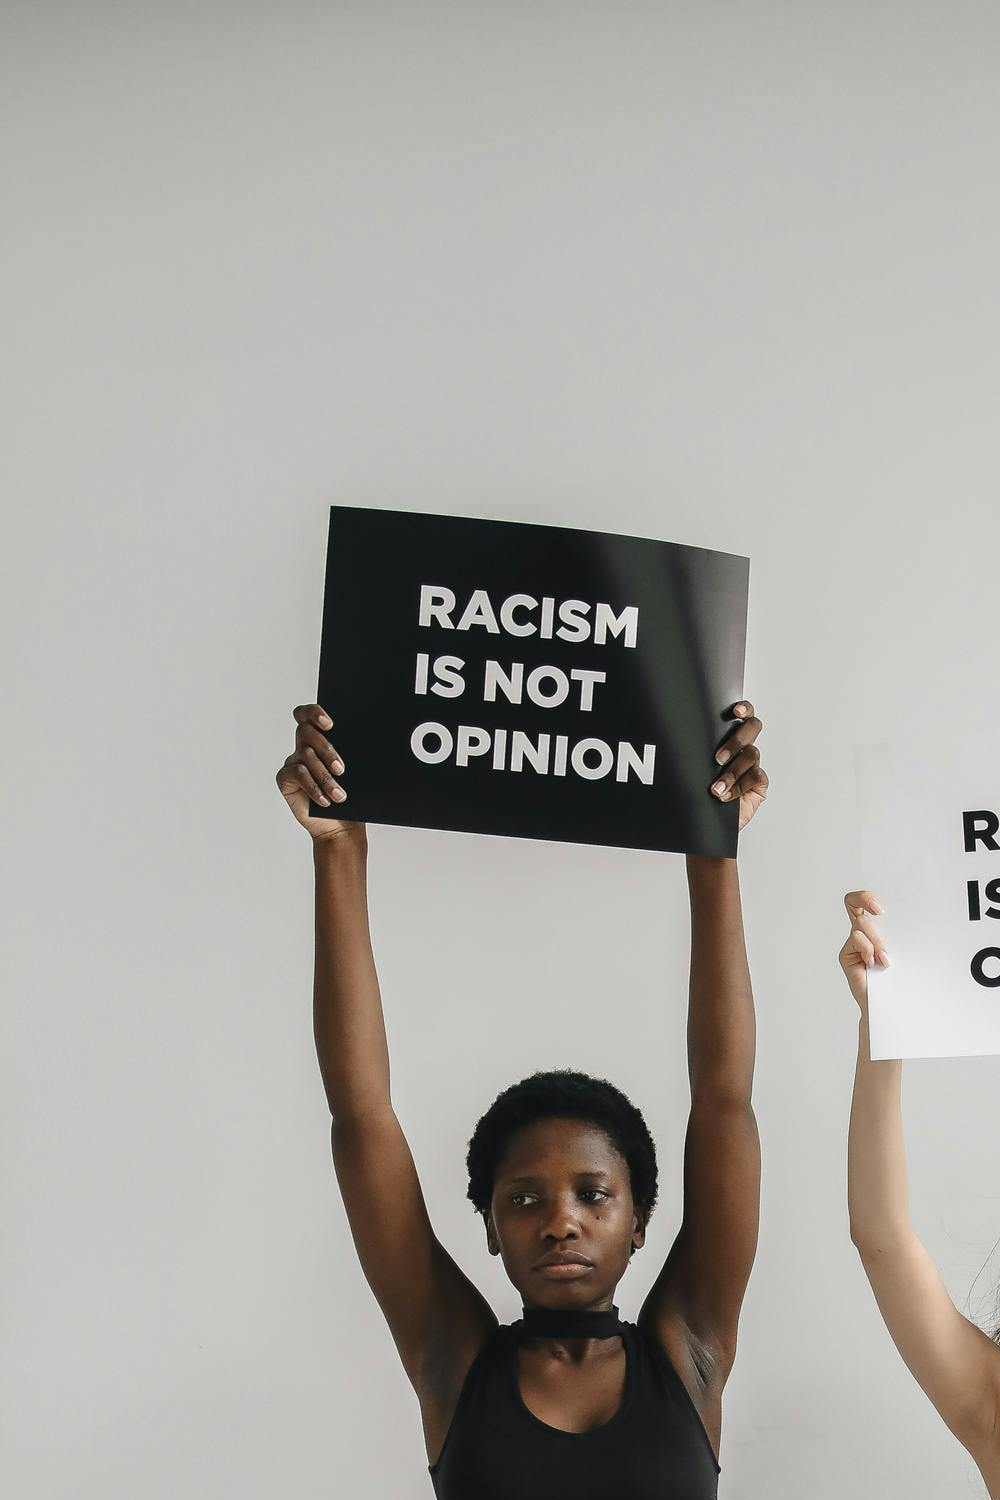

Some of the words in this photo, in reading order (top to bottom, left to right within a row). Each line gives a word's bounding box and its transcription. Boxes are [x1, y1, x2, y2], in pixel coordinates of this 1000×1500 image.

[418, 584, 639, 649] RACISM
[414, 653, 466, 698] IS
[483, 659, 607, 712] NOT
[410, 721, 657, 785] OPINION
